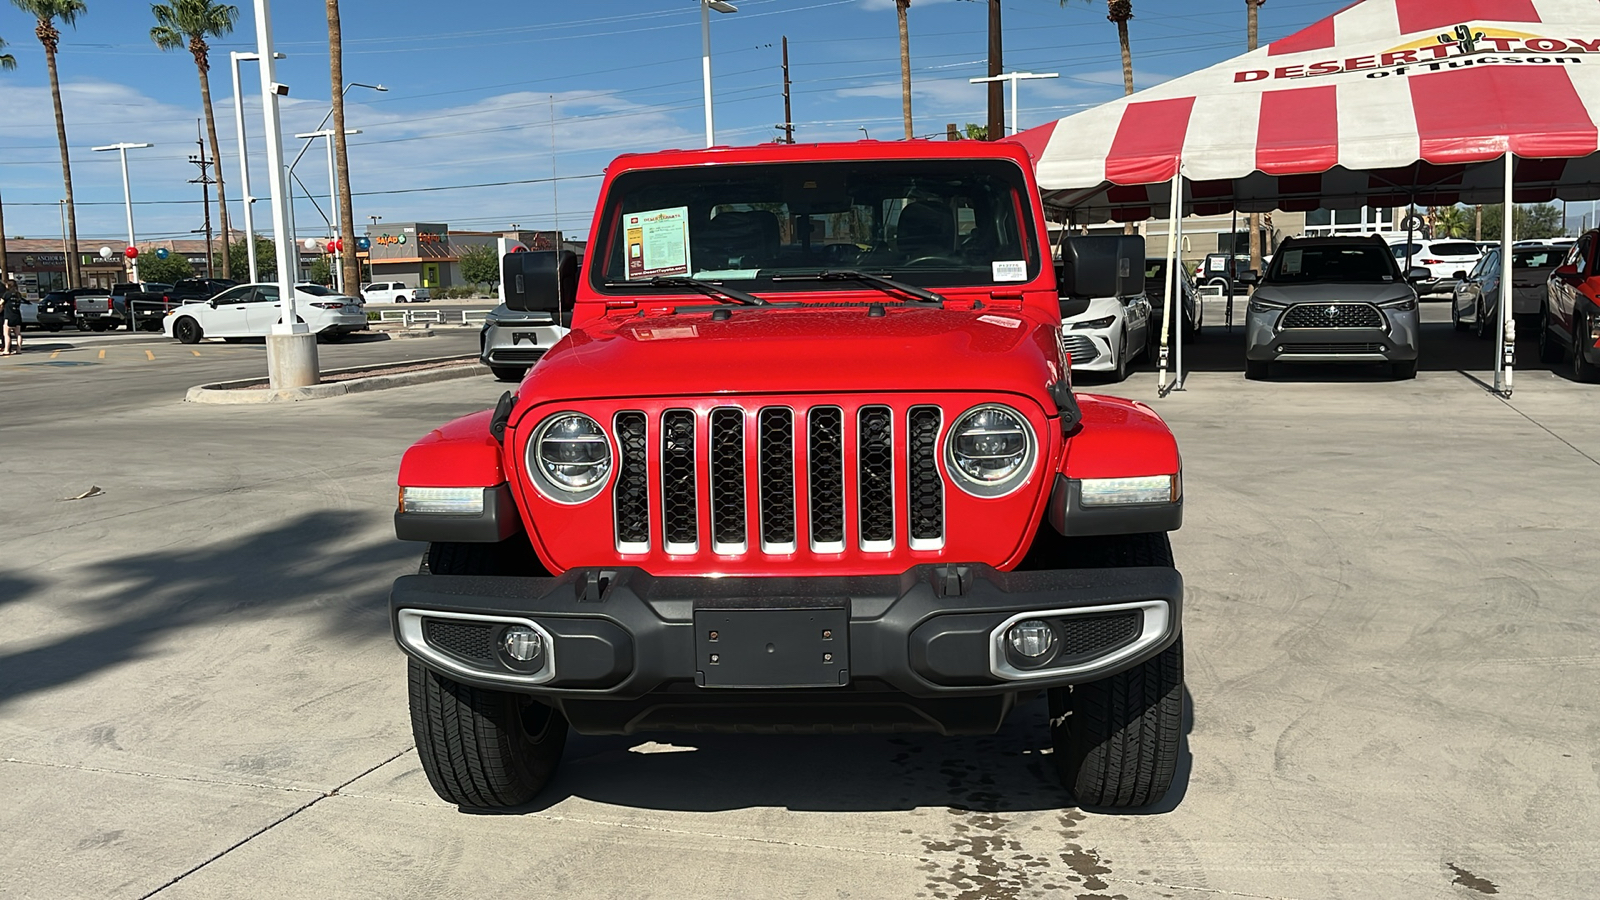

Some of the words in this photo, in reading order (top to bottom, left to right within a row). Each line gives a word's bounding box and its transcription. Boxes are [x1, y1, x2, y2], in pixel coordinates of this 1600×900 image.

[1233, 41, 1460, 83] DESERT
[1365, 67, 1410, 79] of
[1419, 56, 1582, 71] Tucson
